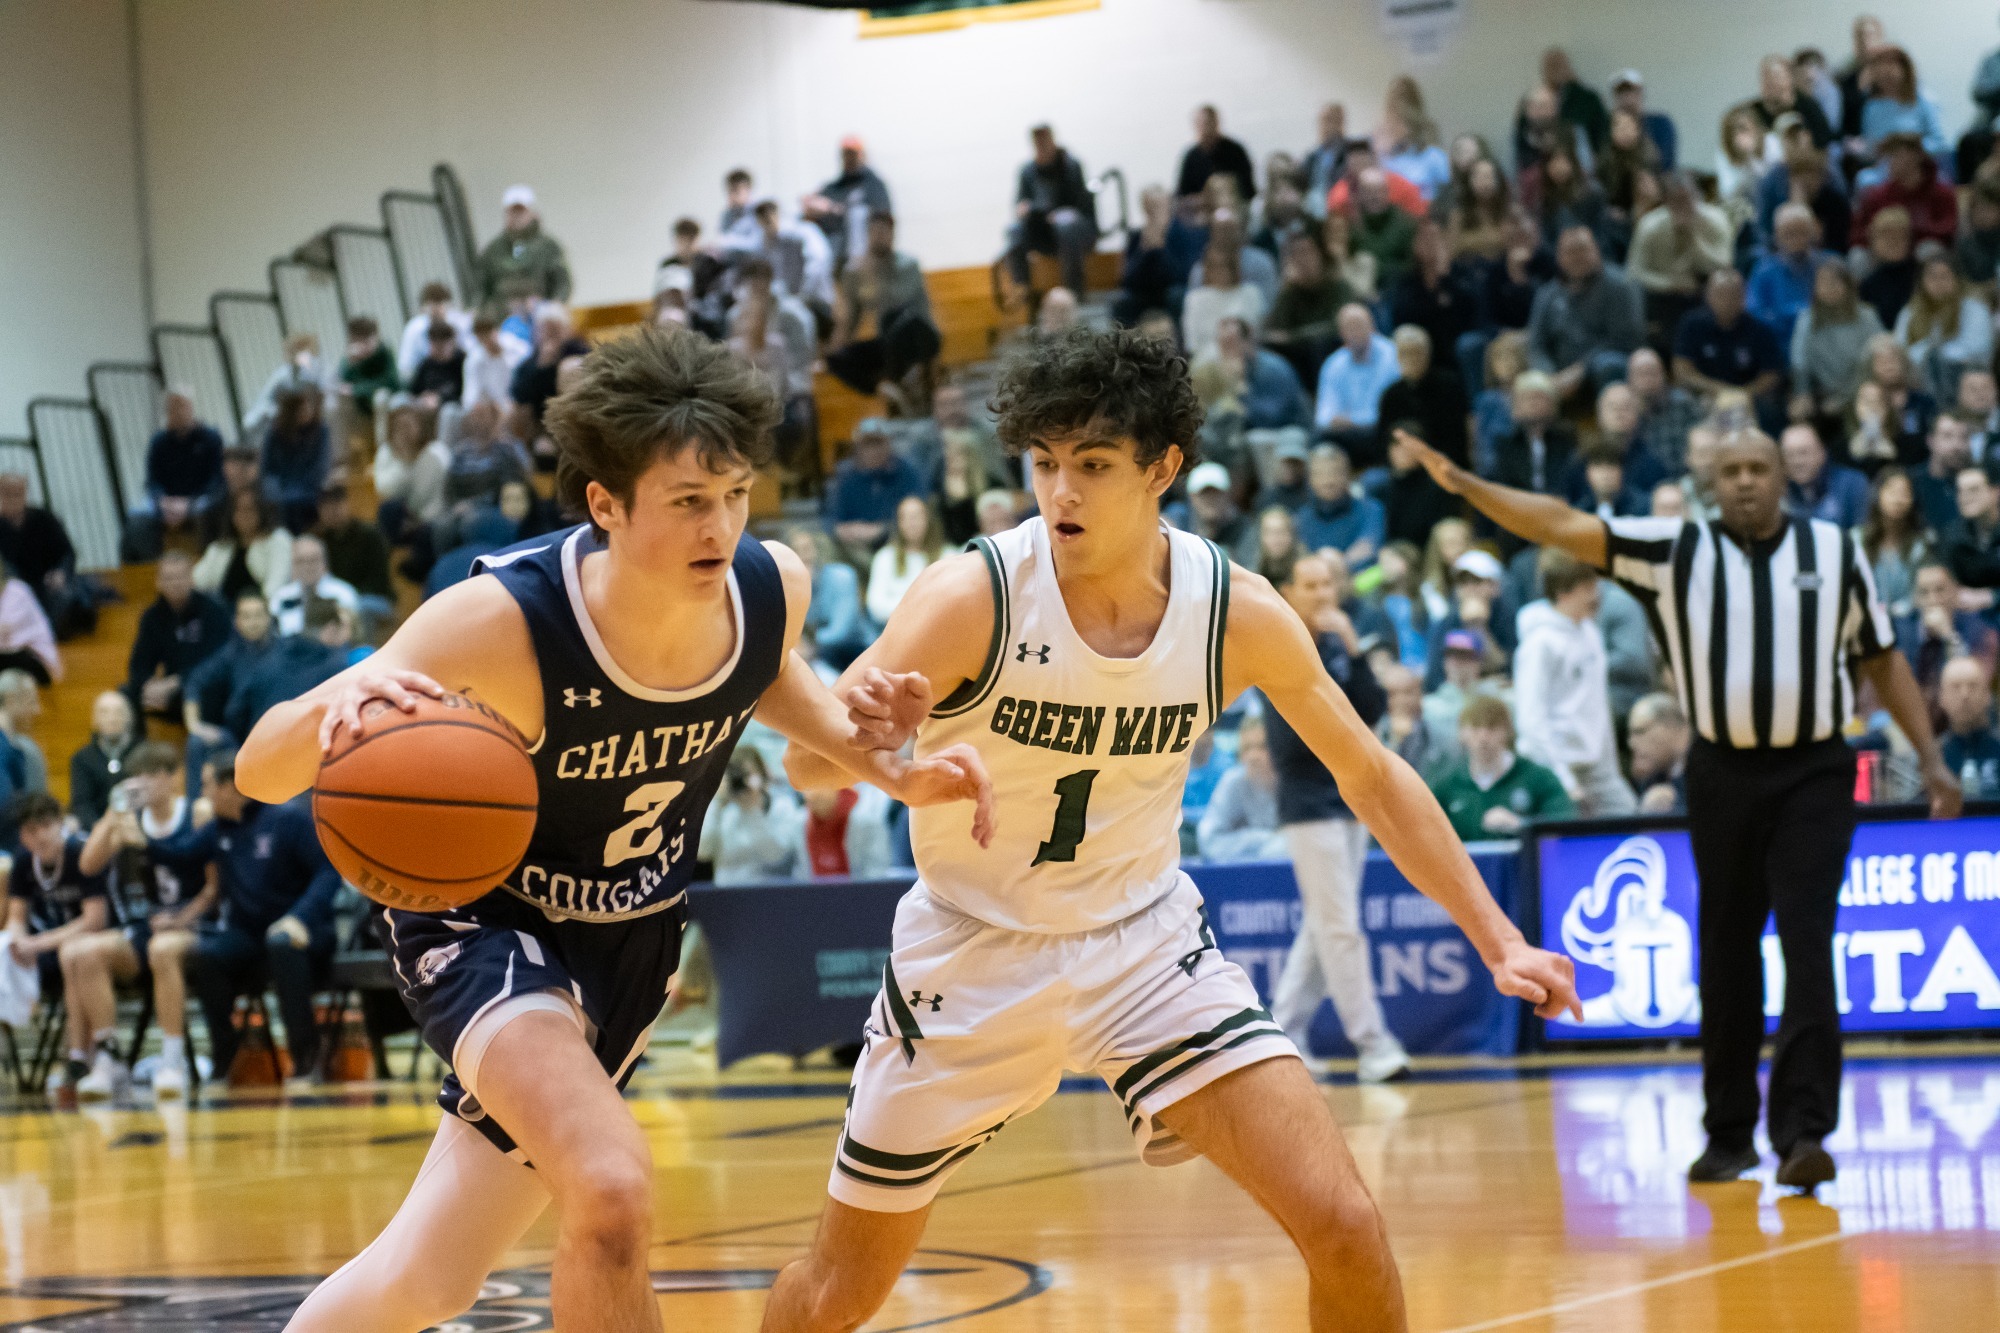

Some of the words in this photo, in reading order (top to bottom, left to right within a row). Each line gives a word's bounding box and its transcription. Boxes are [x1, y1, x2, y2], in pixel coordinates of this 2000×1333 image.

[556, 699, 758, 780] CHATHA
[990, 695, 1106, 756] GREEN
[1109, 702, 1198, 756] WAVE
[602, 781, 686, 868] 2
[1030, 769, 1101, 868] 1
[1921, 852, 1958, 903] OF
